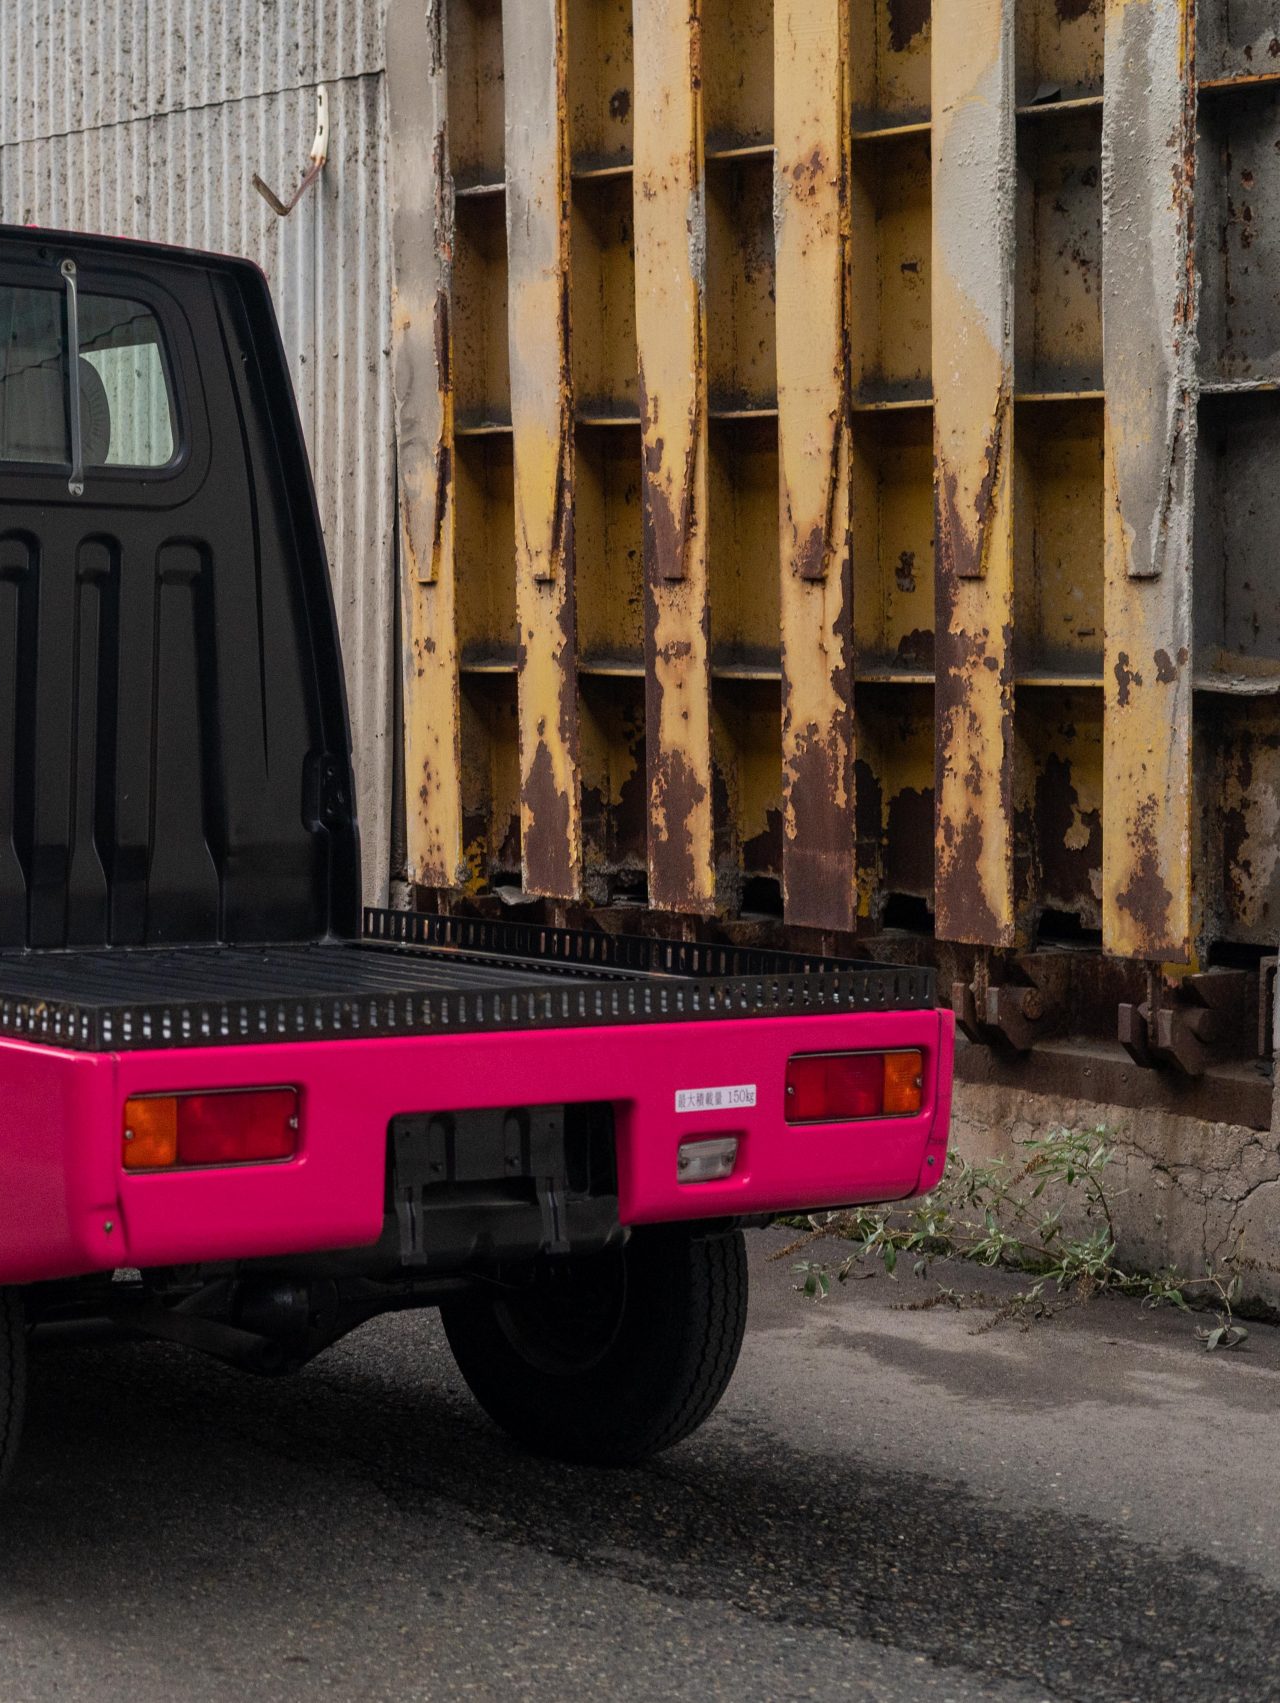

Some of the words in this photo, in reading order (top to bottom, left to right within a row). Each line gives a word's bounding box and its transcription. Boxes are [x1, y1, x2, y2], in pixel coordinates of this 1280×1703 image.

[678, 1091, 722, 1109] 最大積載量
[728, 1088, 754, 1104] 150kg
